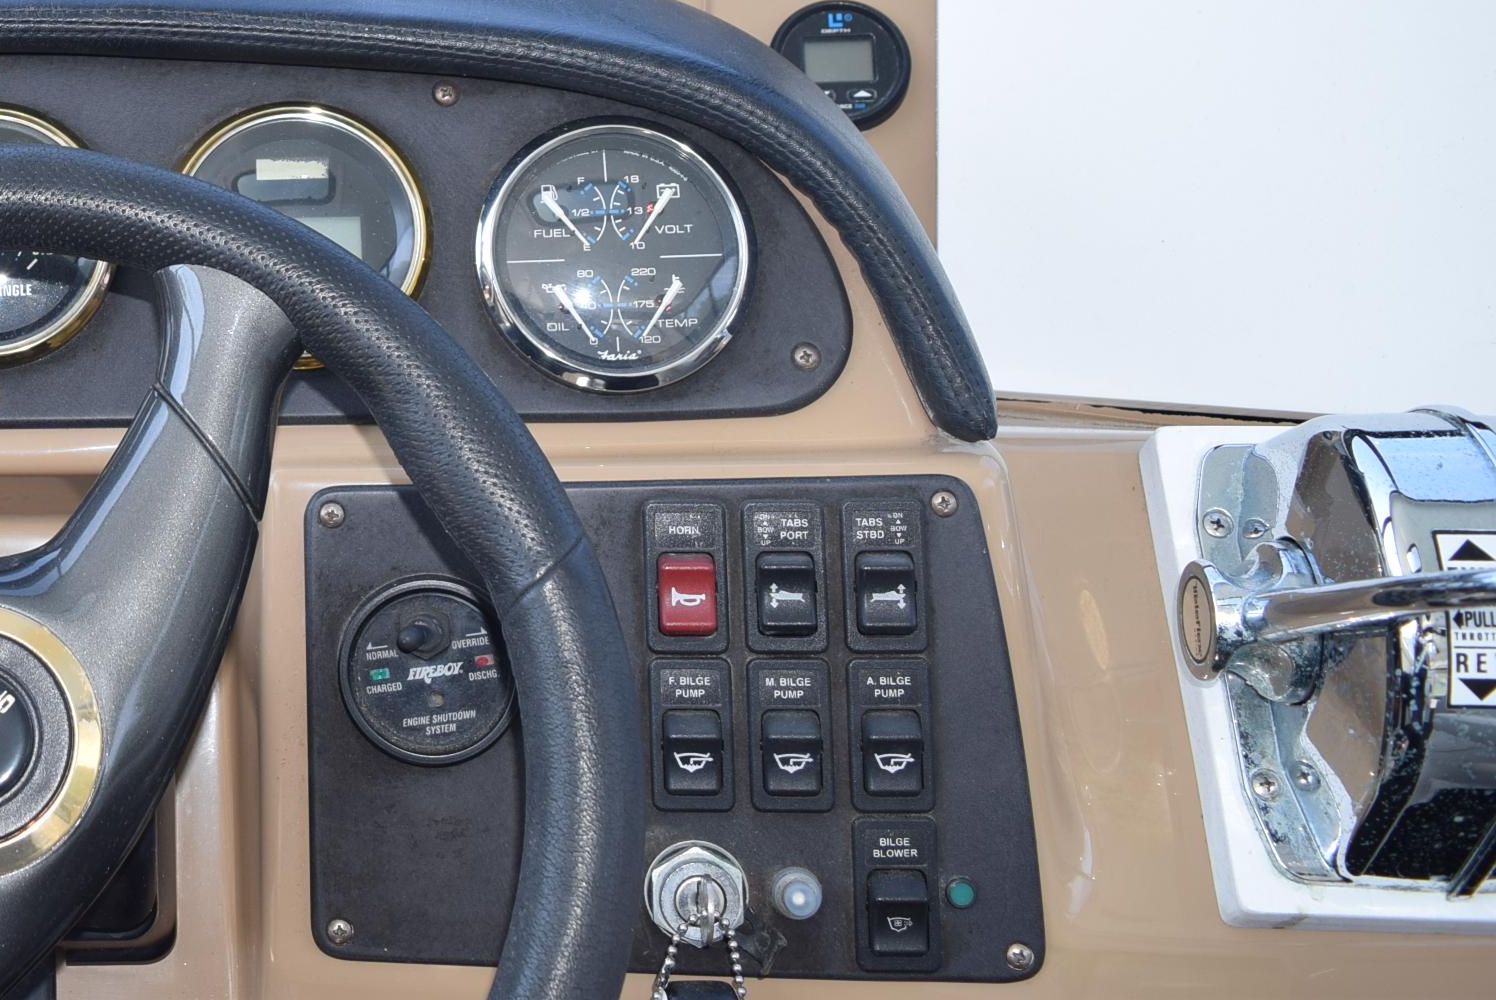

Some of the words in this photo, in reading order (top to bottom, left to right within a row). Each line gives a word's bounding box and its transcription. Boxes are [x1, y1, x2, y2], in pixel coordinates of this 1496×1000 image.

[577, 177, 585, 185] F
[624, 175, 640, 183] 18
[571, 208, 590, 217] 1/2
[627, 207, 643, 215] 13
[533, 228, 571, 238] FUEL
[655, 224, 693, 234] VOLT
[629, 242, 646, 250] 10
[577, 270, 594, 278] 80
[631, 267, 656, 276] 220
[632, 300, 654, 309] 175
[546, 322, 570, 332] OIL
[657, 318, 698, 328] TEMP
[639, 335, 661, 344] 120
[781, 518, 809, 528] TABS
[855, 518, 883, 527] TABS
[668, 525, 700, 535] HORN
[856, 530, 885, 539] STBD
[780, 531, 809, 540] PORT
[1464, 610, 1496, 628] PULL
[451, 635, 490, 650] OVERRIDE
[366, 649, 399, 661] NORMAL
[1456, 652, 1487, 673] RE
[406, 661, 464, 684] FIREBOY
[668, 677, 678, 686] F.
[679, 676, 711, 686] BILGE
[765, 678, 777, 687] M.
[779, 677, 812, 687] BILGE
[866, 677, 877, 685] A.
[879, 676, 912, 685] BILGE
[366, 682, 403, 695] CHARGED
[675, 688, 706, 698] PUMP
[874, 688, 905, 697] PUMP
[773, 689, 804, 699] PUMP
[402, 715, 431, 728] ENGINE
[432, 710, 477, 723] SHUTDOWN
[425, 724, 457, 735] SYSTEM
[879, 837, 911, 847] BILGE
[872, 848, 918, 858] BLOWER
